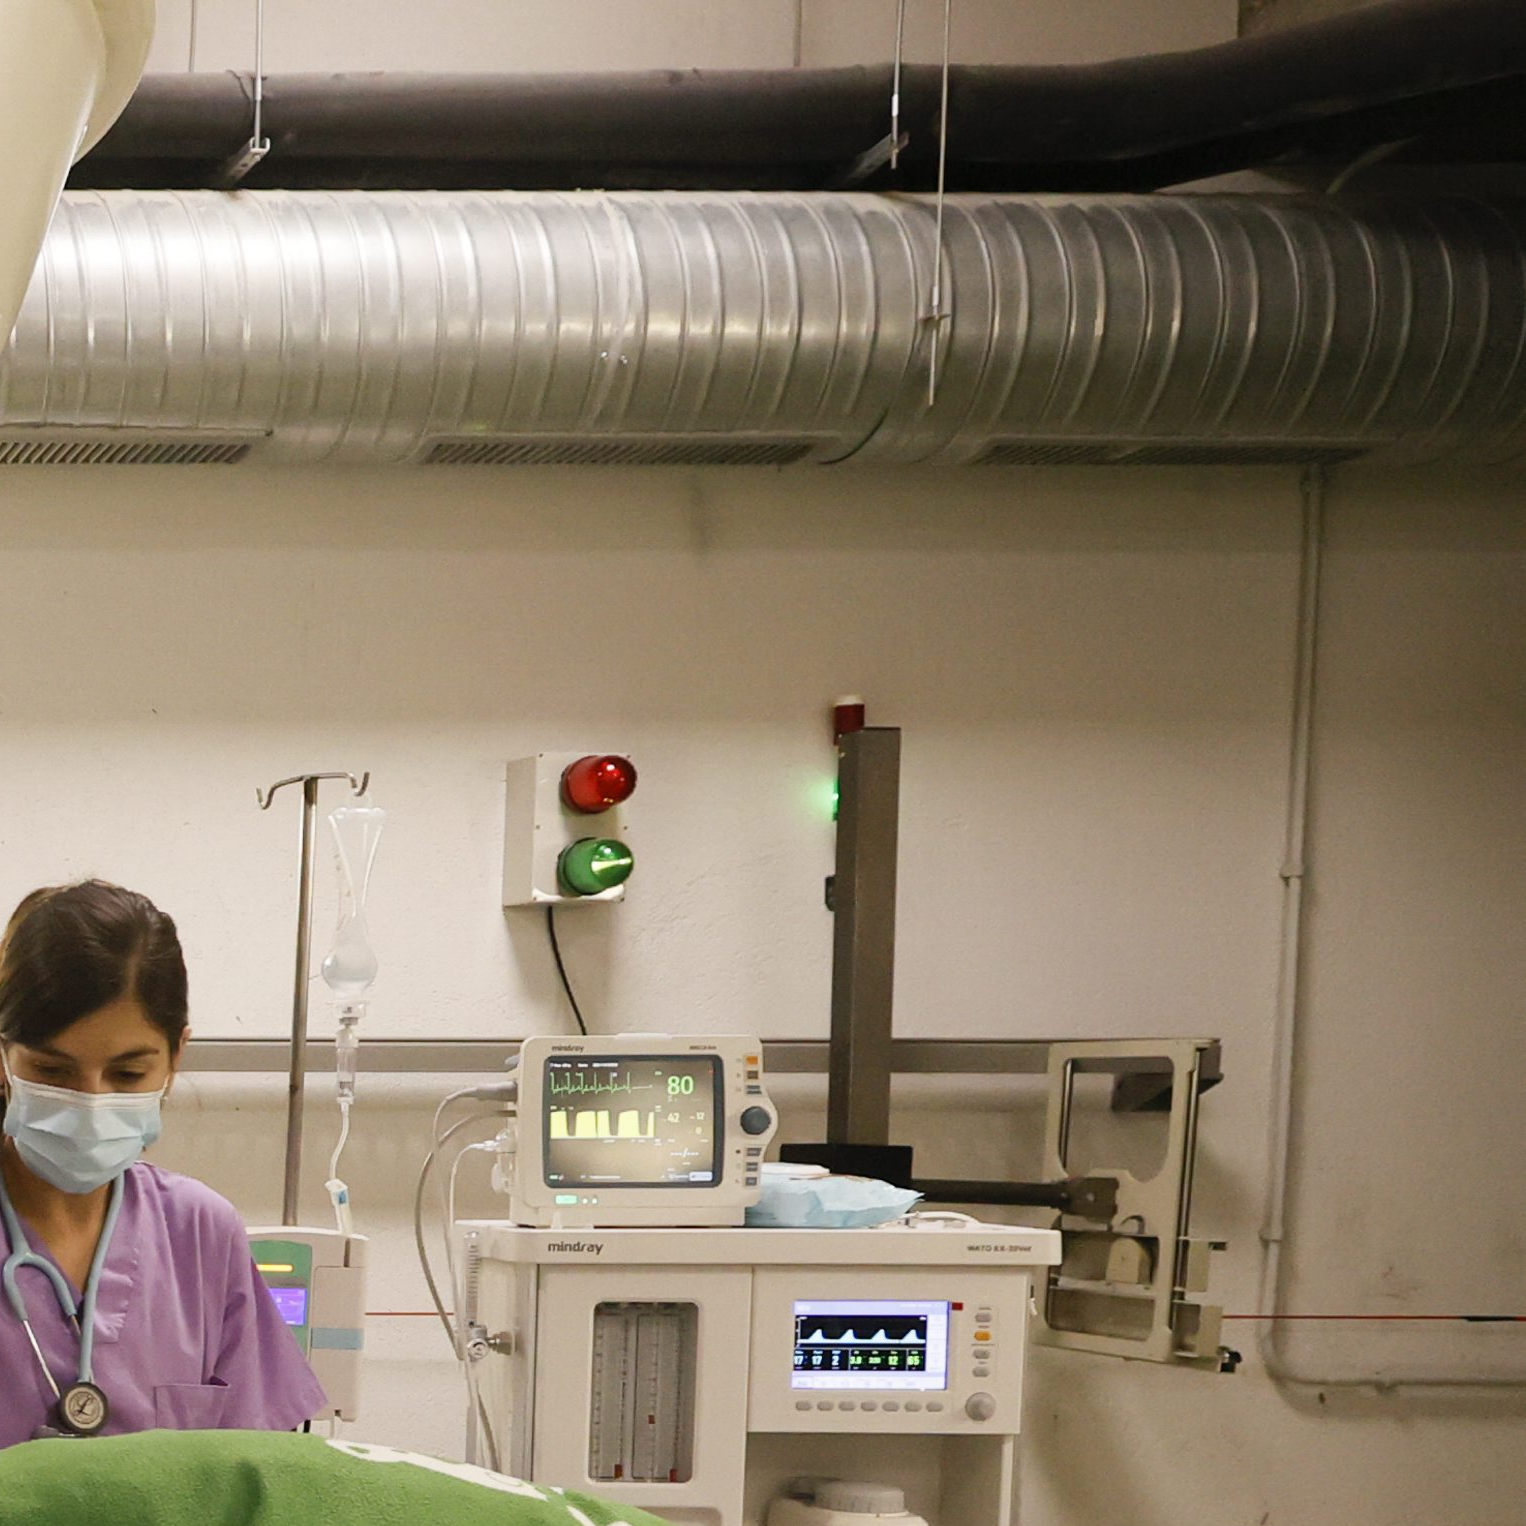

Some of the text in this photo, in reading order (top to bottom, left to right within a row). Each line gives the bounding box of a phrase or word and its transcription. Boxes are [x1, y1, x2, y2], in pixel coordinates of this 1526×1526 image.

[667, 1076, 694, 1095] 80
[547, 1241, 604, 1255] mindray
[812, 1355, 823, 1365] 17
[831, 1355, 839, 1365] 2
